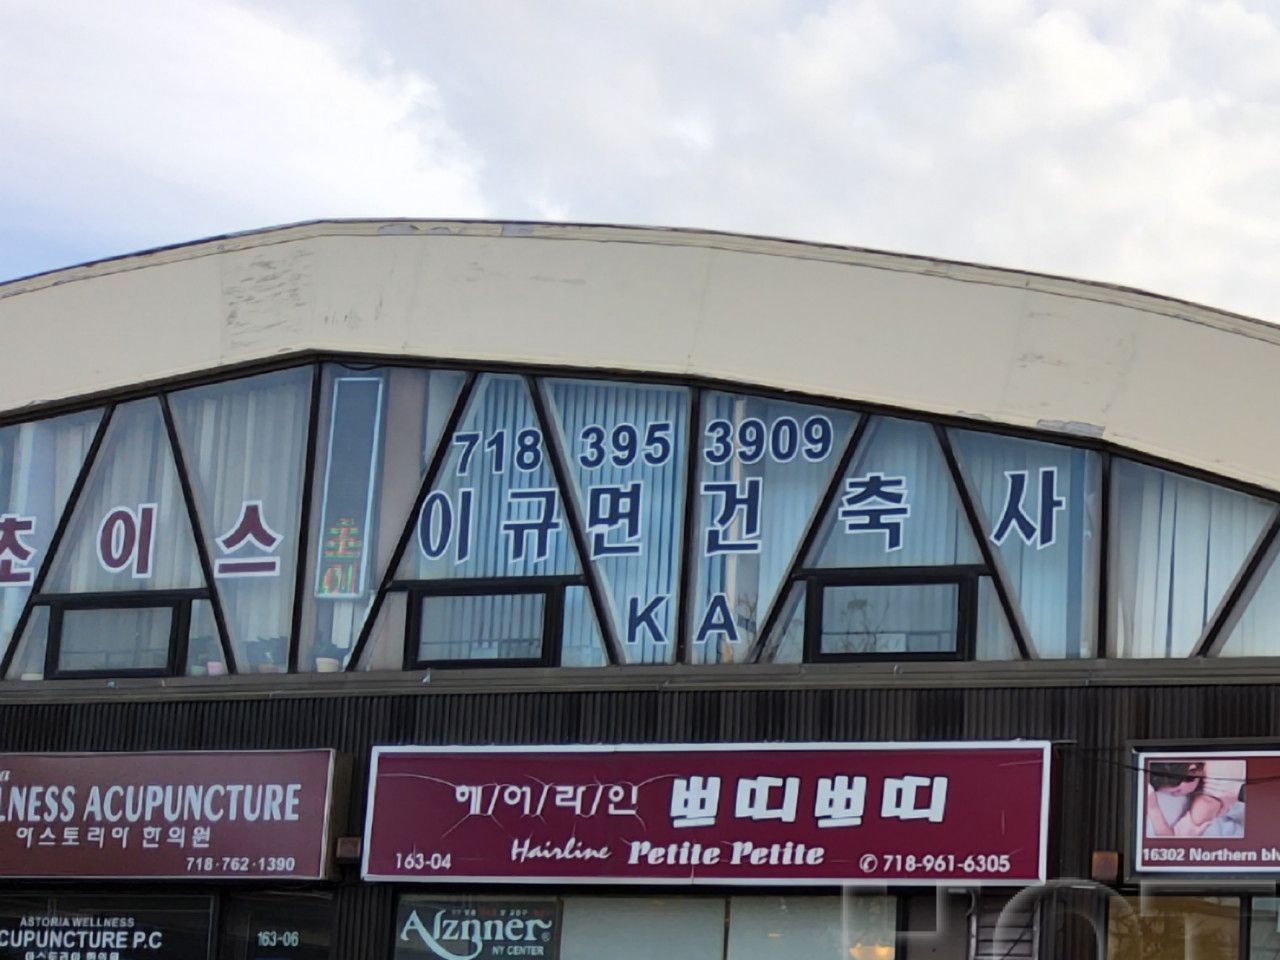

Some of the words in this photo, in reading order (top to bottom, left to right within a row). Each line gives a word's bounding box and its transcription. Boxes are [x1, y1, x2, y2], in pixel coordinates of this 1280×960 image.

[453, 429, 544, 476] 718
[578, 422, 673, 470] 395
[703, 416, 834, 466] 3909
[83, 783, 302, 822] ACUPUNCTURE
[16, 826, 130, 848] 아스토리아
[143, 826, 211, 848] 한의원
[395, 851, 452, 870] 163-04
[511, 838, 611, 862] Hairline
[627, 841, 721, 866] Petite
[730, 841, 825, 866] Petite
[1142, 848, 1185, 861] 16302
[1189, 848, 1257, 861] Northern
[882, 853, 1011, 874] 718-961-6305
[20, 917, 69, 927] ASTORIA
[72, 917, 135, 927] WELLNESS
[133, 931, 163, 949] P.C
[258, 931, 299, 947] 163-06
[492, 946, 505, 955] NY
[507, 946, 544, 955] CENTER
